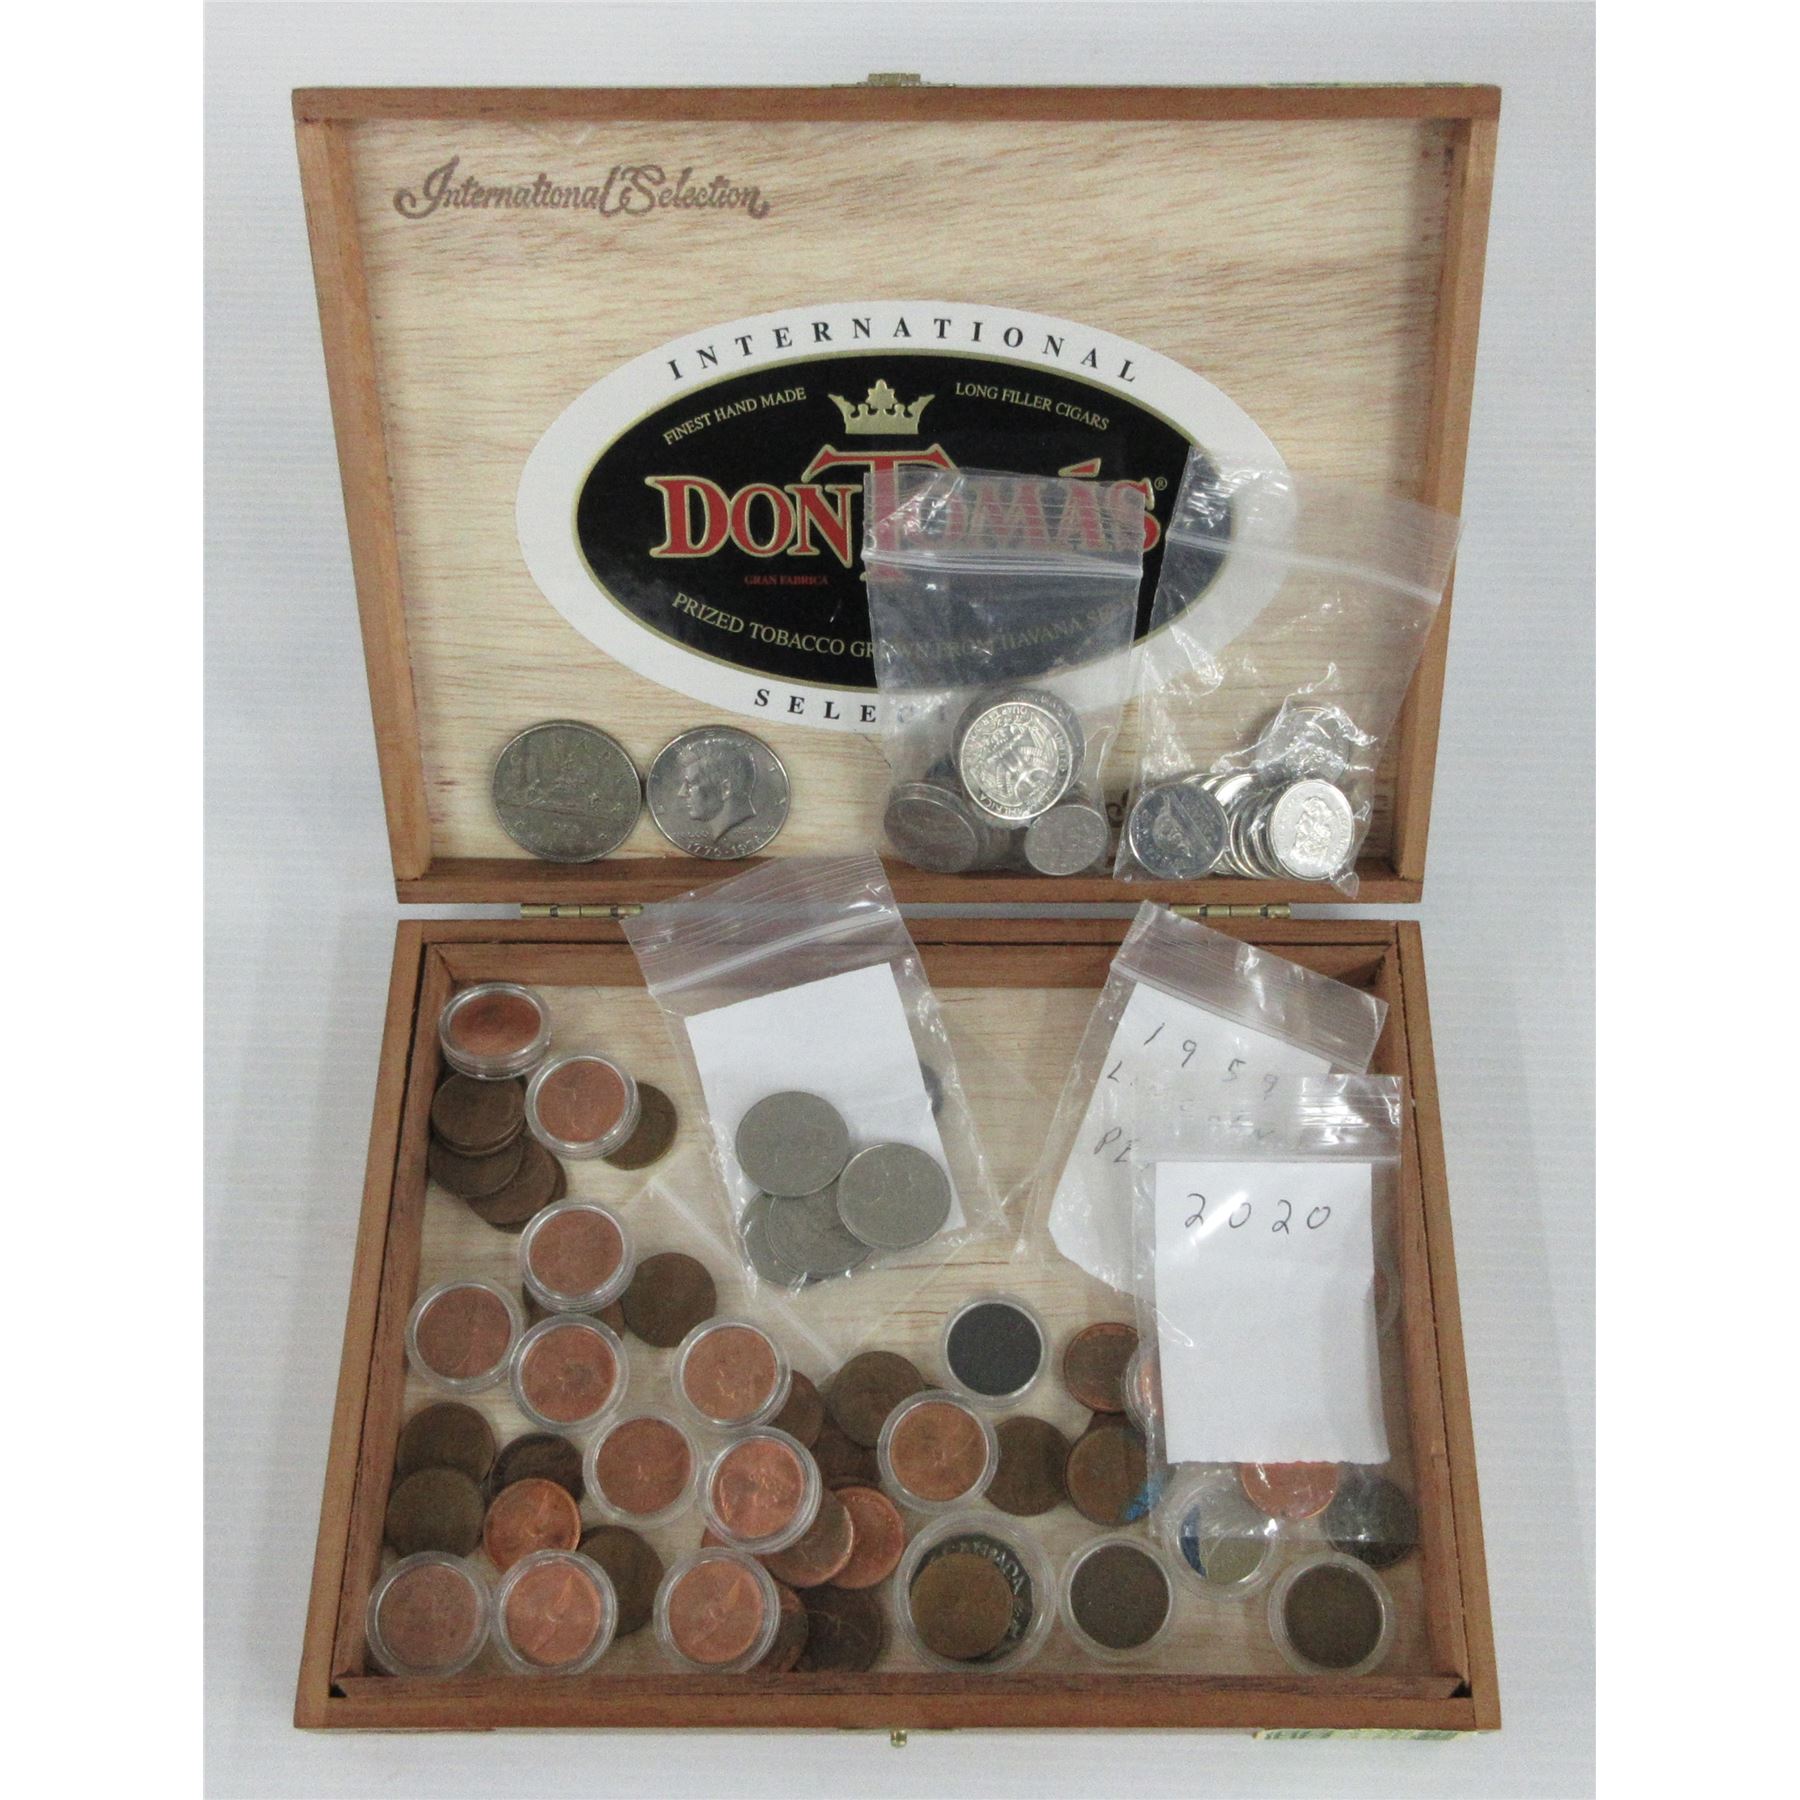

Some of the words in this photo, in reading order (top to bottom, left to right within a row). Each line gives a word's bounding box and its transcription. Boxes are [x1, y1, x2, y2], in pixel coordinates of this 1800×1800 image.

[393, 154, 620, 219] International
[619, 164, 771, 219] Selection
[667, 317, 1136, 383] INTERNATIONAL
[662, 413, 712, 446] FINEST
[714, 398, 757, 423] HAND
[760, 387, 807, 409] MADE
[955, 382, 998, 400] LONG
[1001, 388, 1053, 412] FILLER
[1055, 402, 1110, 431] CIGARS
[645, 474, 863, 568] DON
[744, 575, 777, 585] GRAN
[779, 575, 829, 585] FABRICA
[671, 592, 745, 634] PRIZED
[749, 622, 846, 655] TOBACCO
[1144, 1022, 1279, 1101] 1959
[1185, 1192, 1331, 1235] 2020
